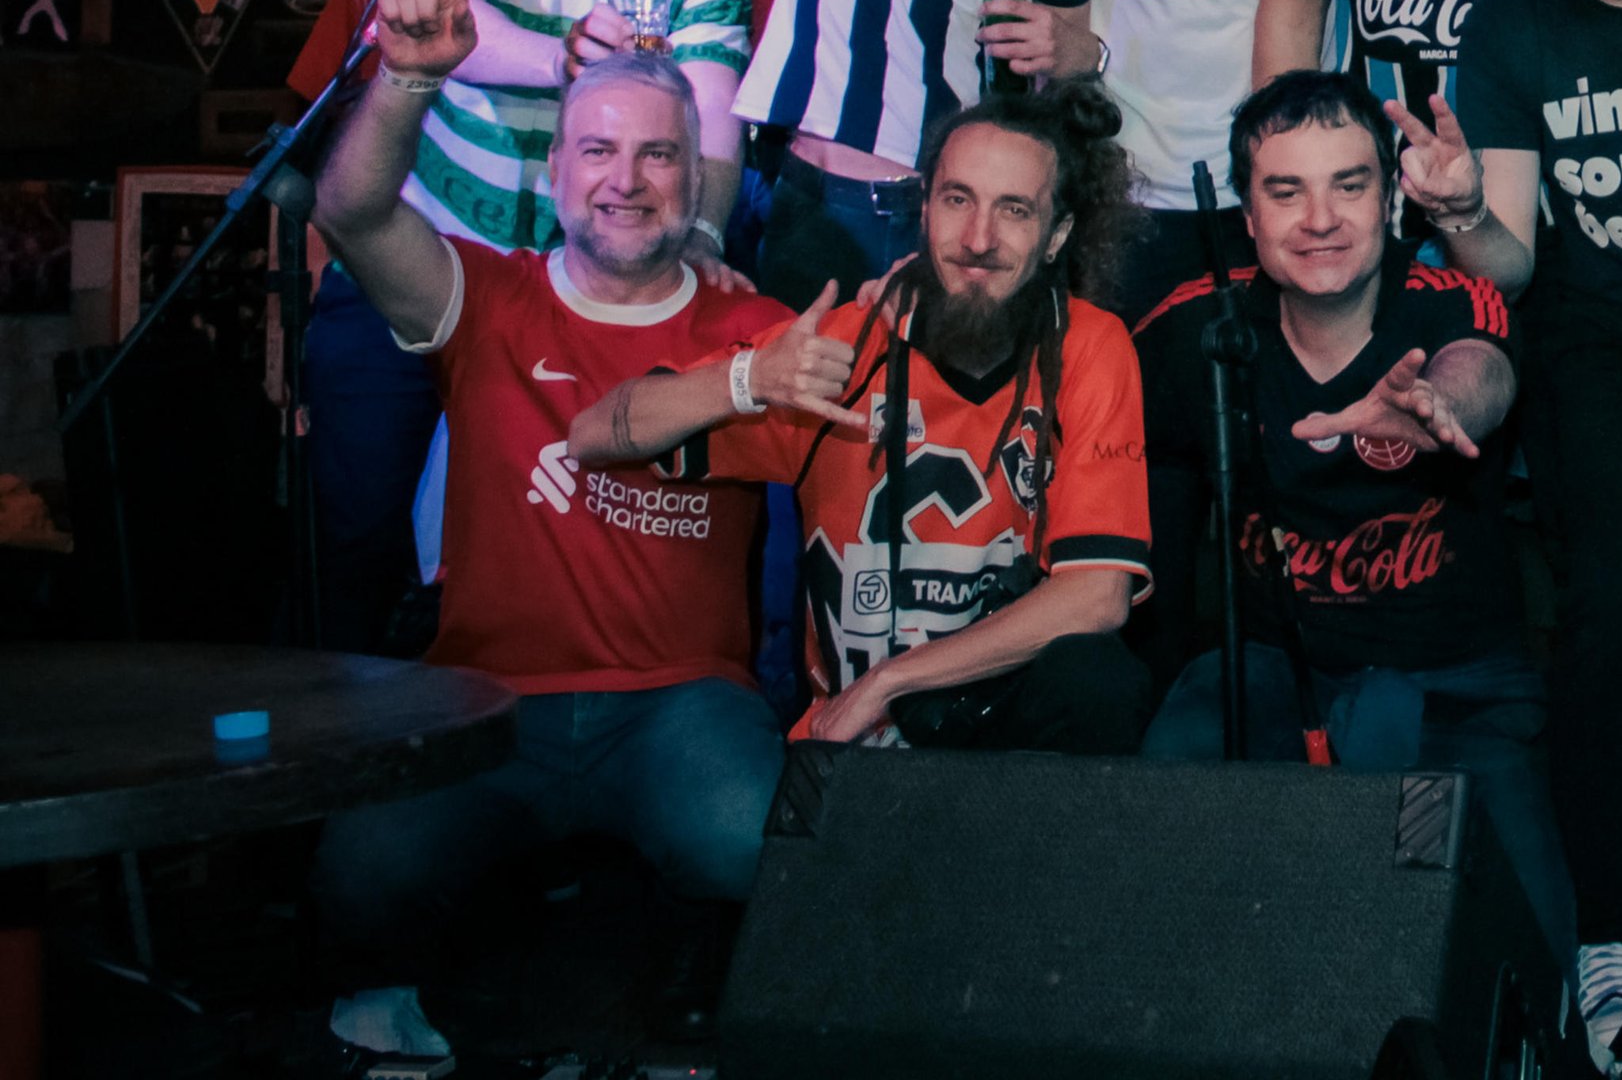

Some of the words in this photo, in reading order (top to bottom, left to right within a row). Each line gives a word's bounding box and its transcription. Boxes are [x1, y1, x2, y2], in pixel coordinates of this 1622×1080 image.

[1419, 50, 1448, 60] MARCA
[586, 471, 710, 515] standard
[584, 494, 712, 540] chartered
